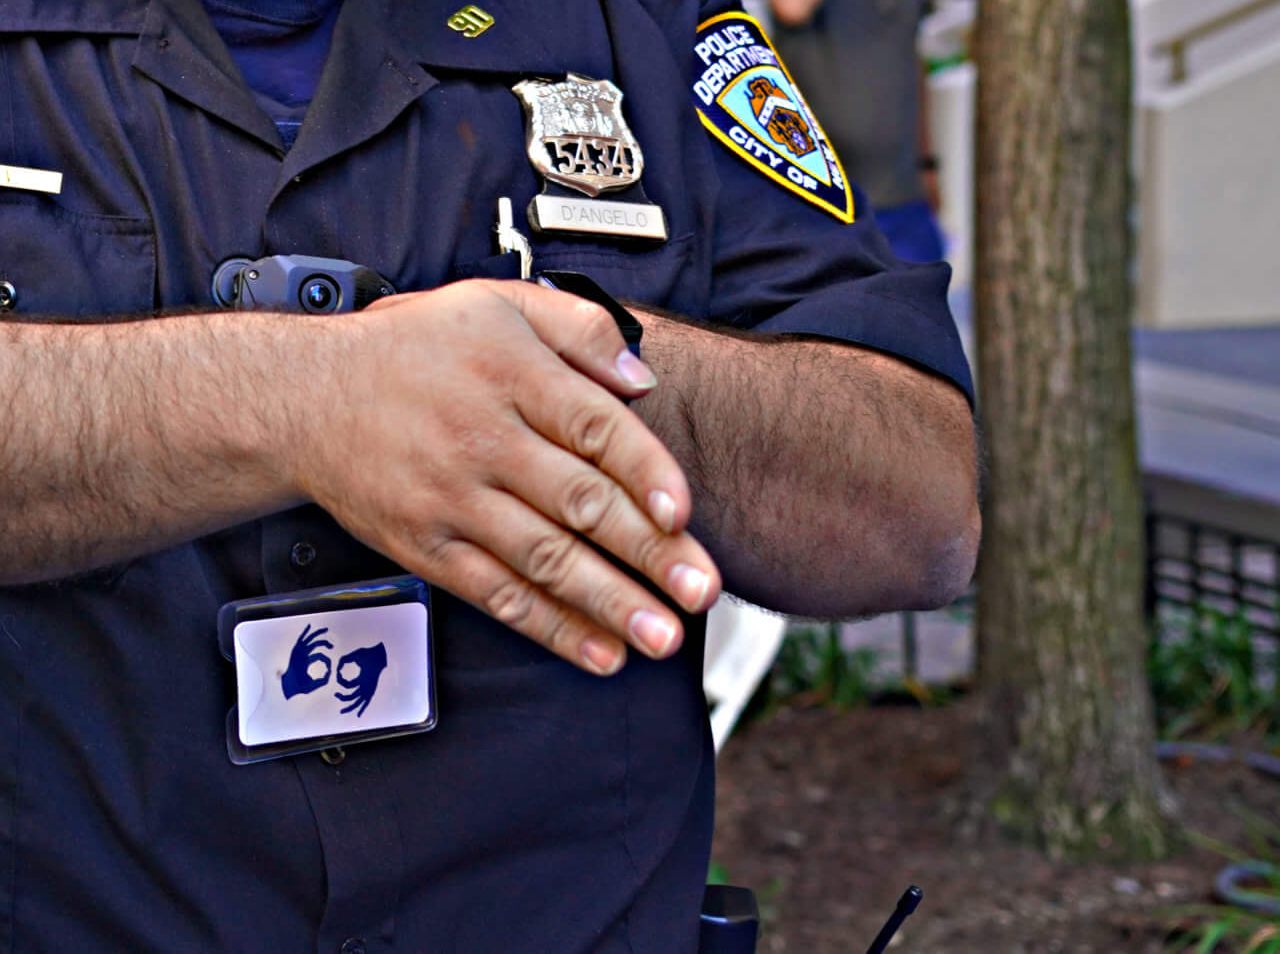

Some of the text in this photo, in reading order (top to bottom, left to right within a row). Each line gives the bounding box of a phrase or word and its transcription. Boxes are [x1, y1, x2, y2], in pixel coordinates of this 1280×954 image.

[694, 25, 755, 66] POLICE
[552, 137, 633, 178] 5434
[728, 125, 783, 169] CITY
[786, 165, 819, 191] OF
[560, 204, 649, 228] D'ANGELO
